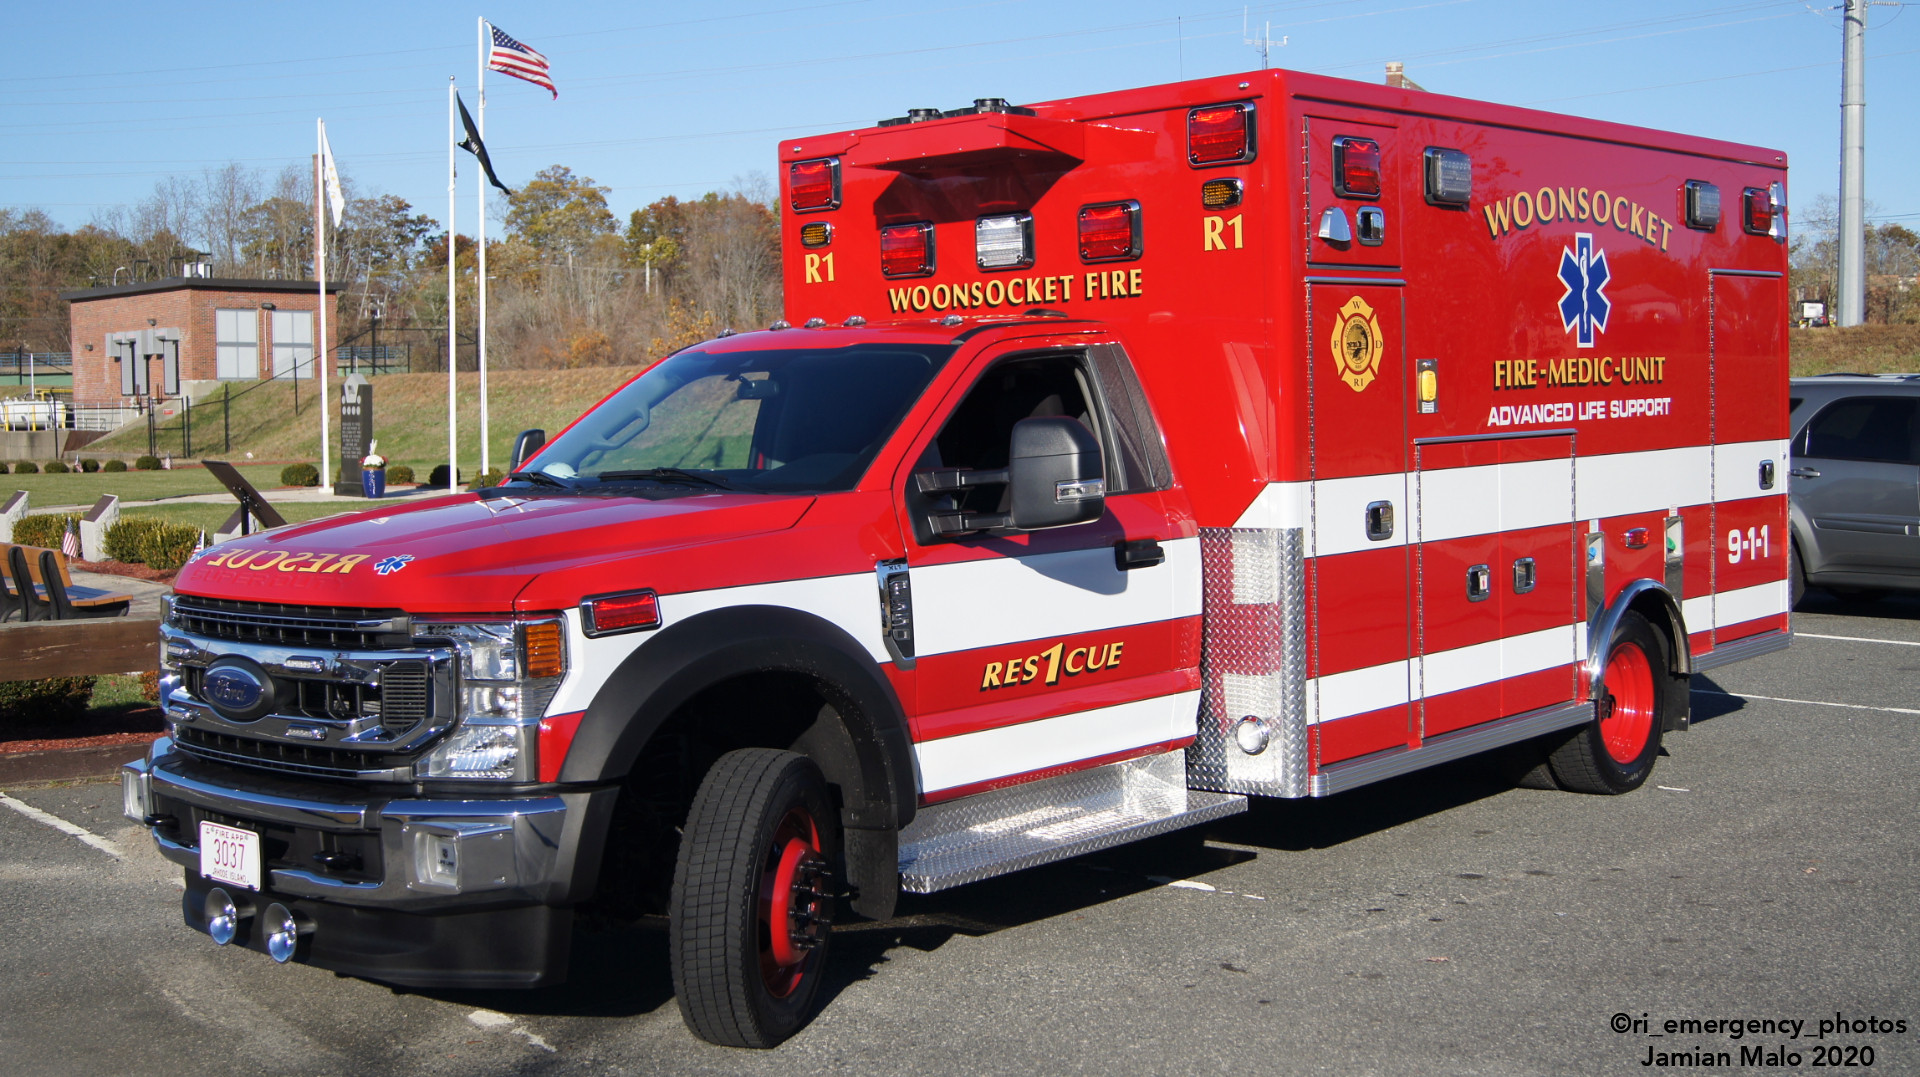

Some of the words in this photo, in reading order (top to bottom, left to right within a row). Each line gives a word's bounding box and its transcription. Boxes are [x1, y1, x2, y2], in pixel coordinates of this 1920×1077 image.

[1203, 214, 1245, 252] R1
[1483, 187, 1673, 252] WOONSOCKET
[804, 252, 835, 284] R1
[889, 274, 1074, 313] WOONSOCKET
[1084, 268, 1143, 299] FIRE
[1352, 300, 1362, 309] W
[1333, 340, 1340, 349] F
[1375, 340, 1383, 349] D
[1493, 356, 1666, 391] FIRE-MEDIC-UNIT
[1487, 402, 1573, 427] ADVANCED
[1578, 400, 1606, 421] LIFE
[1610, 397, 1671, 418] SUPPORT
[1728, 524, 1769, 564] 9-1-1
[214, 675, 246, 701] Ford
[214, 838, 245, 870] 3037
